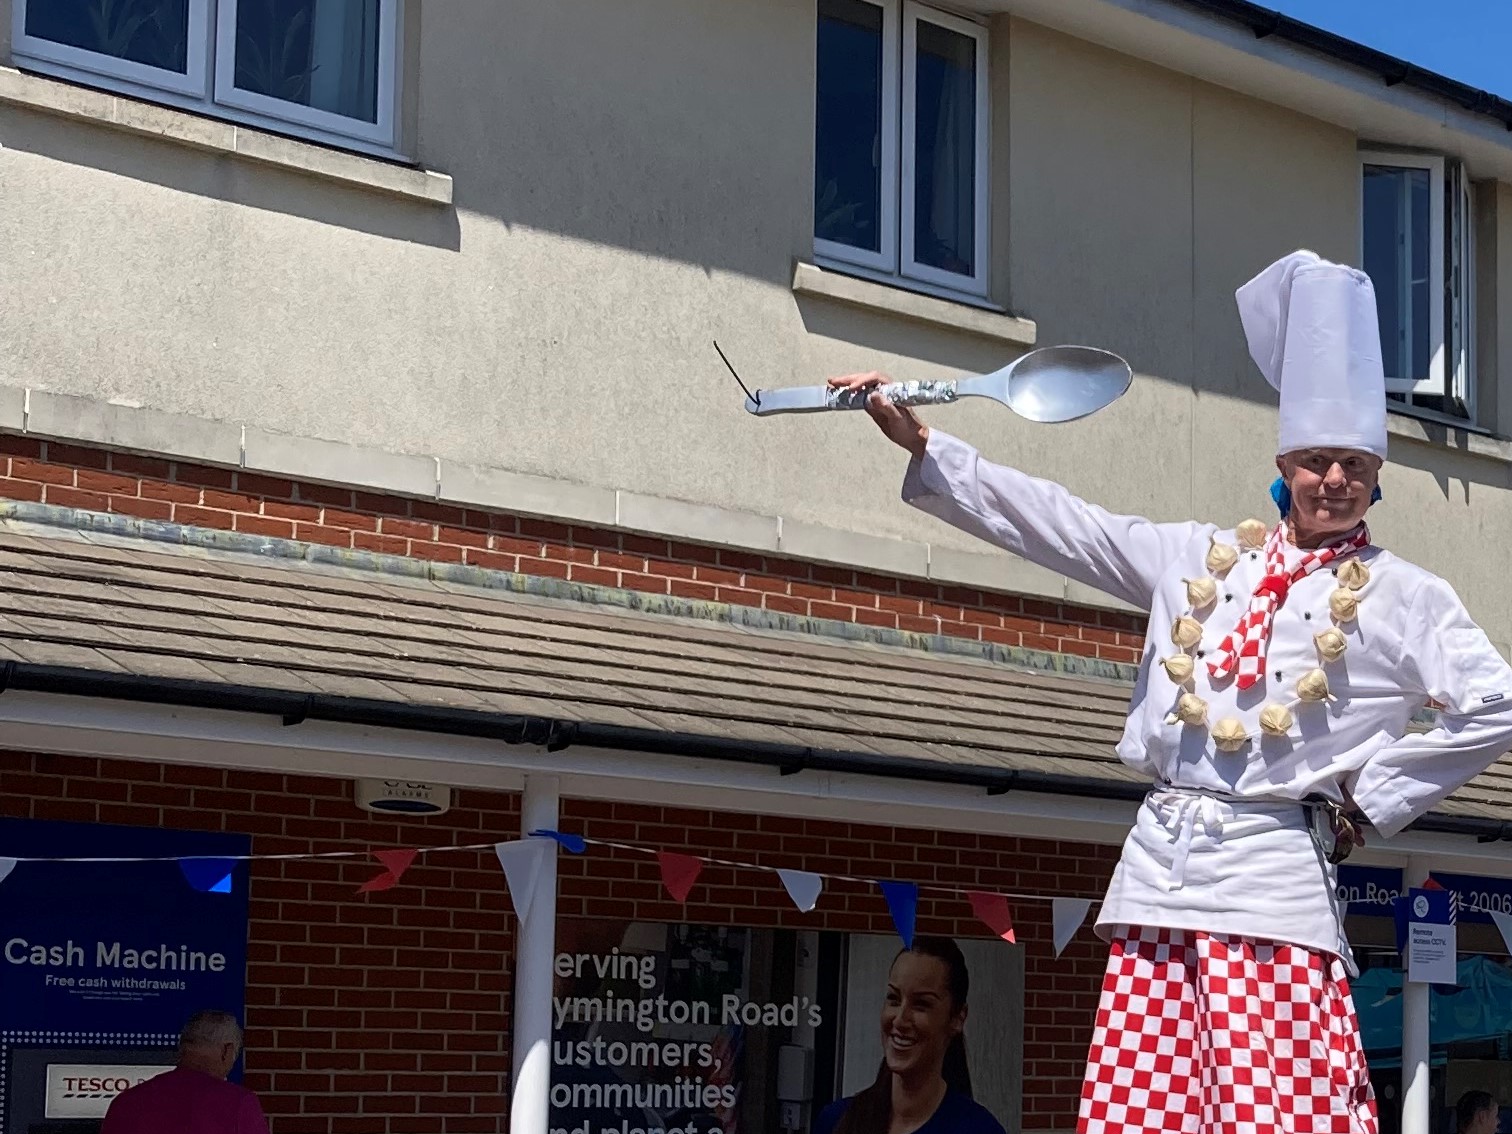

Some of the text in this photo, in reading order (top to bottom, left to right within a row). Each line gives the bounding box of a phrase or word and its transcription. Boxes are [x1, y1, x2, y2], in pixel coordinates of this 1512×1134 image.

[1365, 881, 1400, 906] Roa
[1469, 890, 1512, 915] 2006
[4, 937, 227, 973] Cash Machine
[554, 946, 657, 990] erving
[44, 974, 187, 993] Free cash withdrawals
[553, 989, 711, 1033] ymington
[553, 1035, 723, 1074] ustomers,
[62, 1077, 130, 1092] TESCO
[549, 1075, 738, 1109] ommunities
